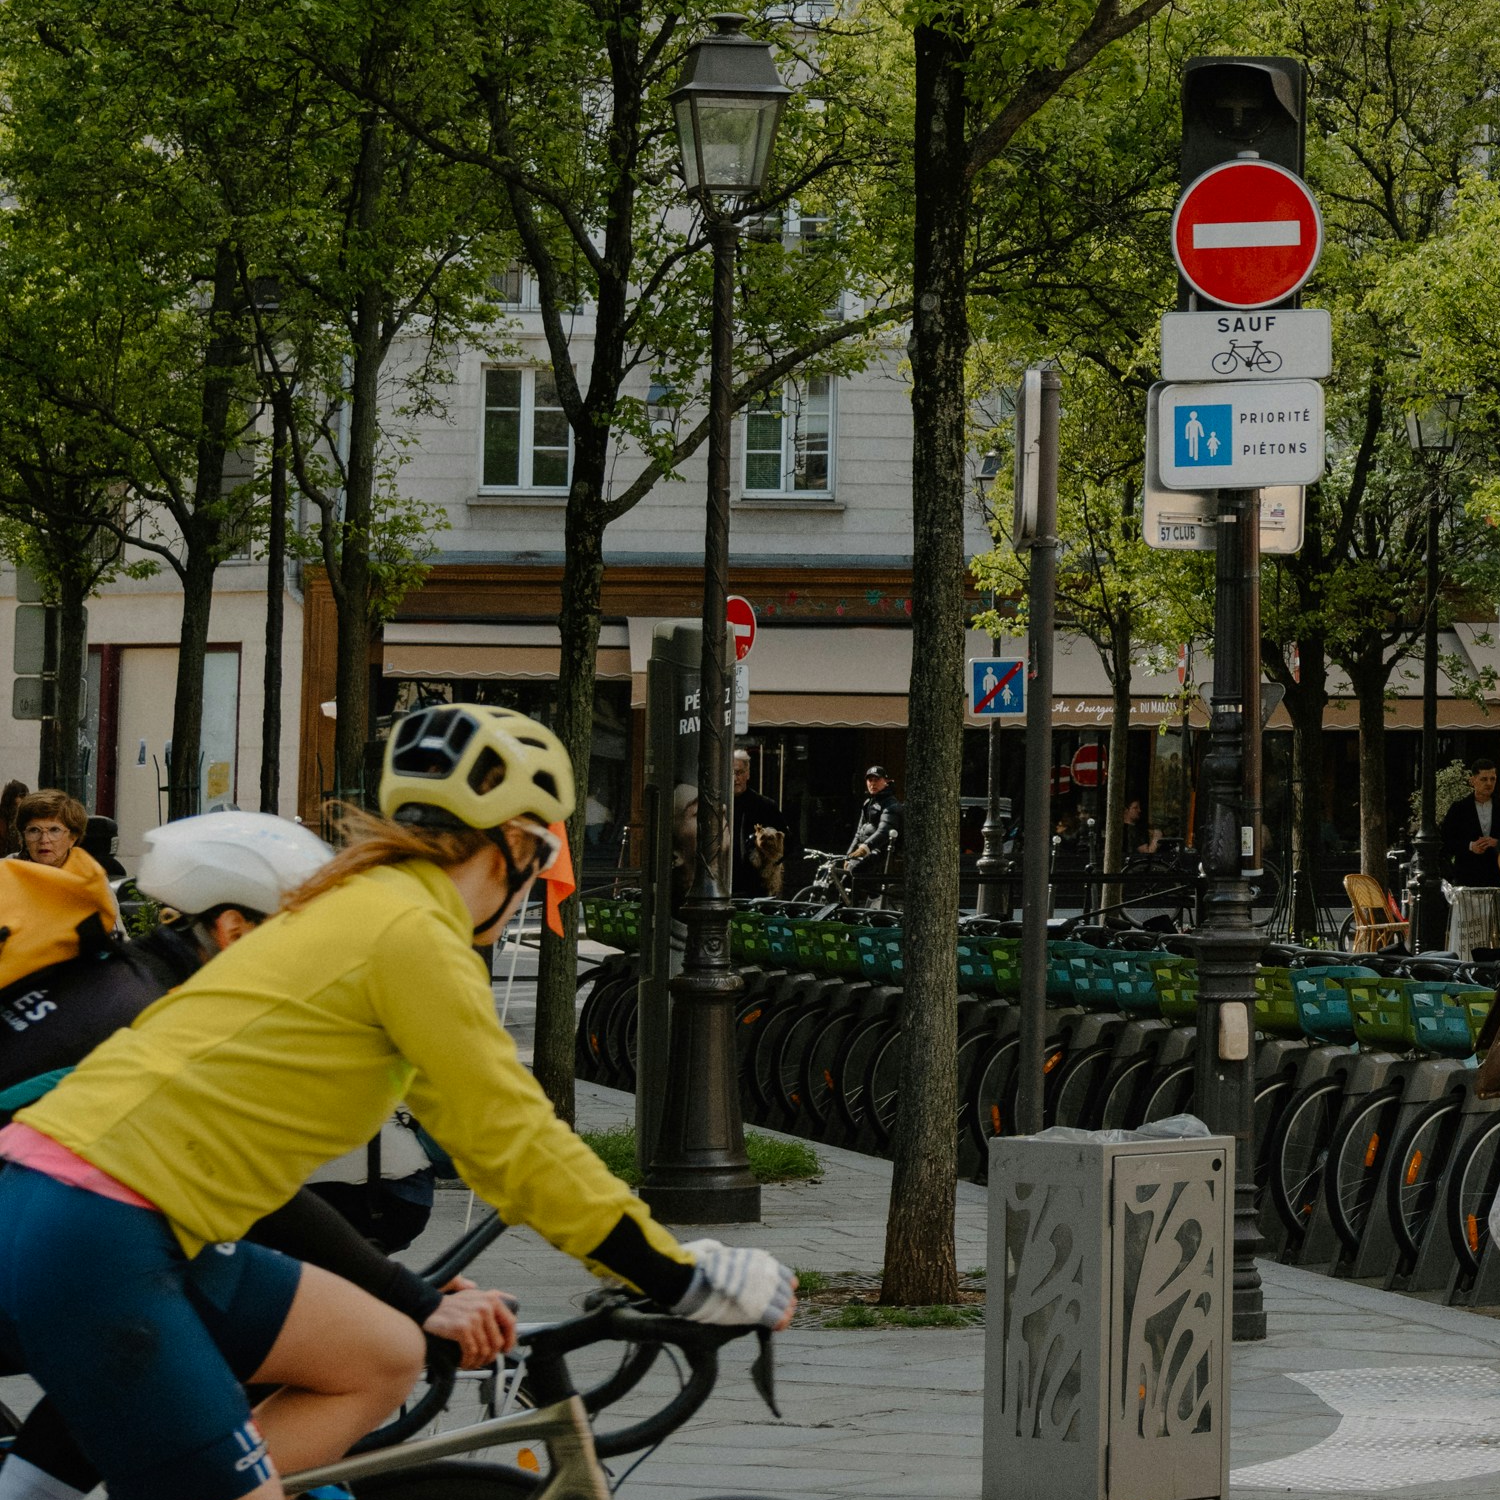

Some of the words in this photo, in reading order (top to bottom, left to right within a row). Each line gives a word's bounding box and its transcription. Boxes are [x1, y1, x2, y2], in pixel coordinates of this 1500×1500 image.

[1217, 316, 1276, 333] SAUF
[1240, 408, 1310, 424] PRIORITÉ
[1243, 441, 1307, 456] PIÉTONS
[1160, 527, 1171, 541] 57
[1173, 525, 1195, 541] CLUB
[1141, 702, 1150, 713] DU
